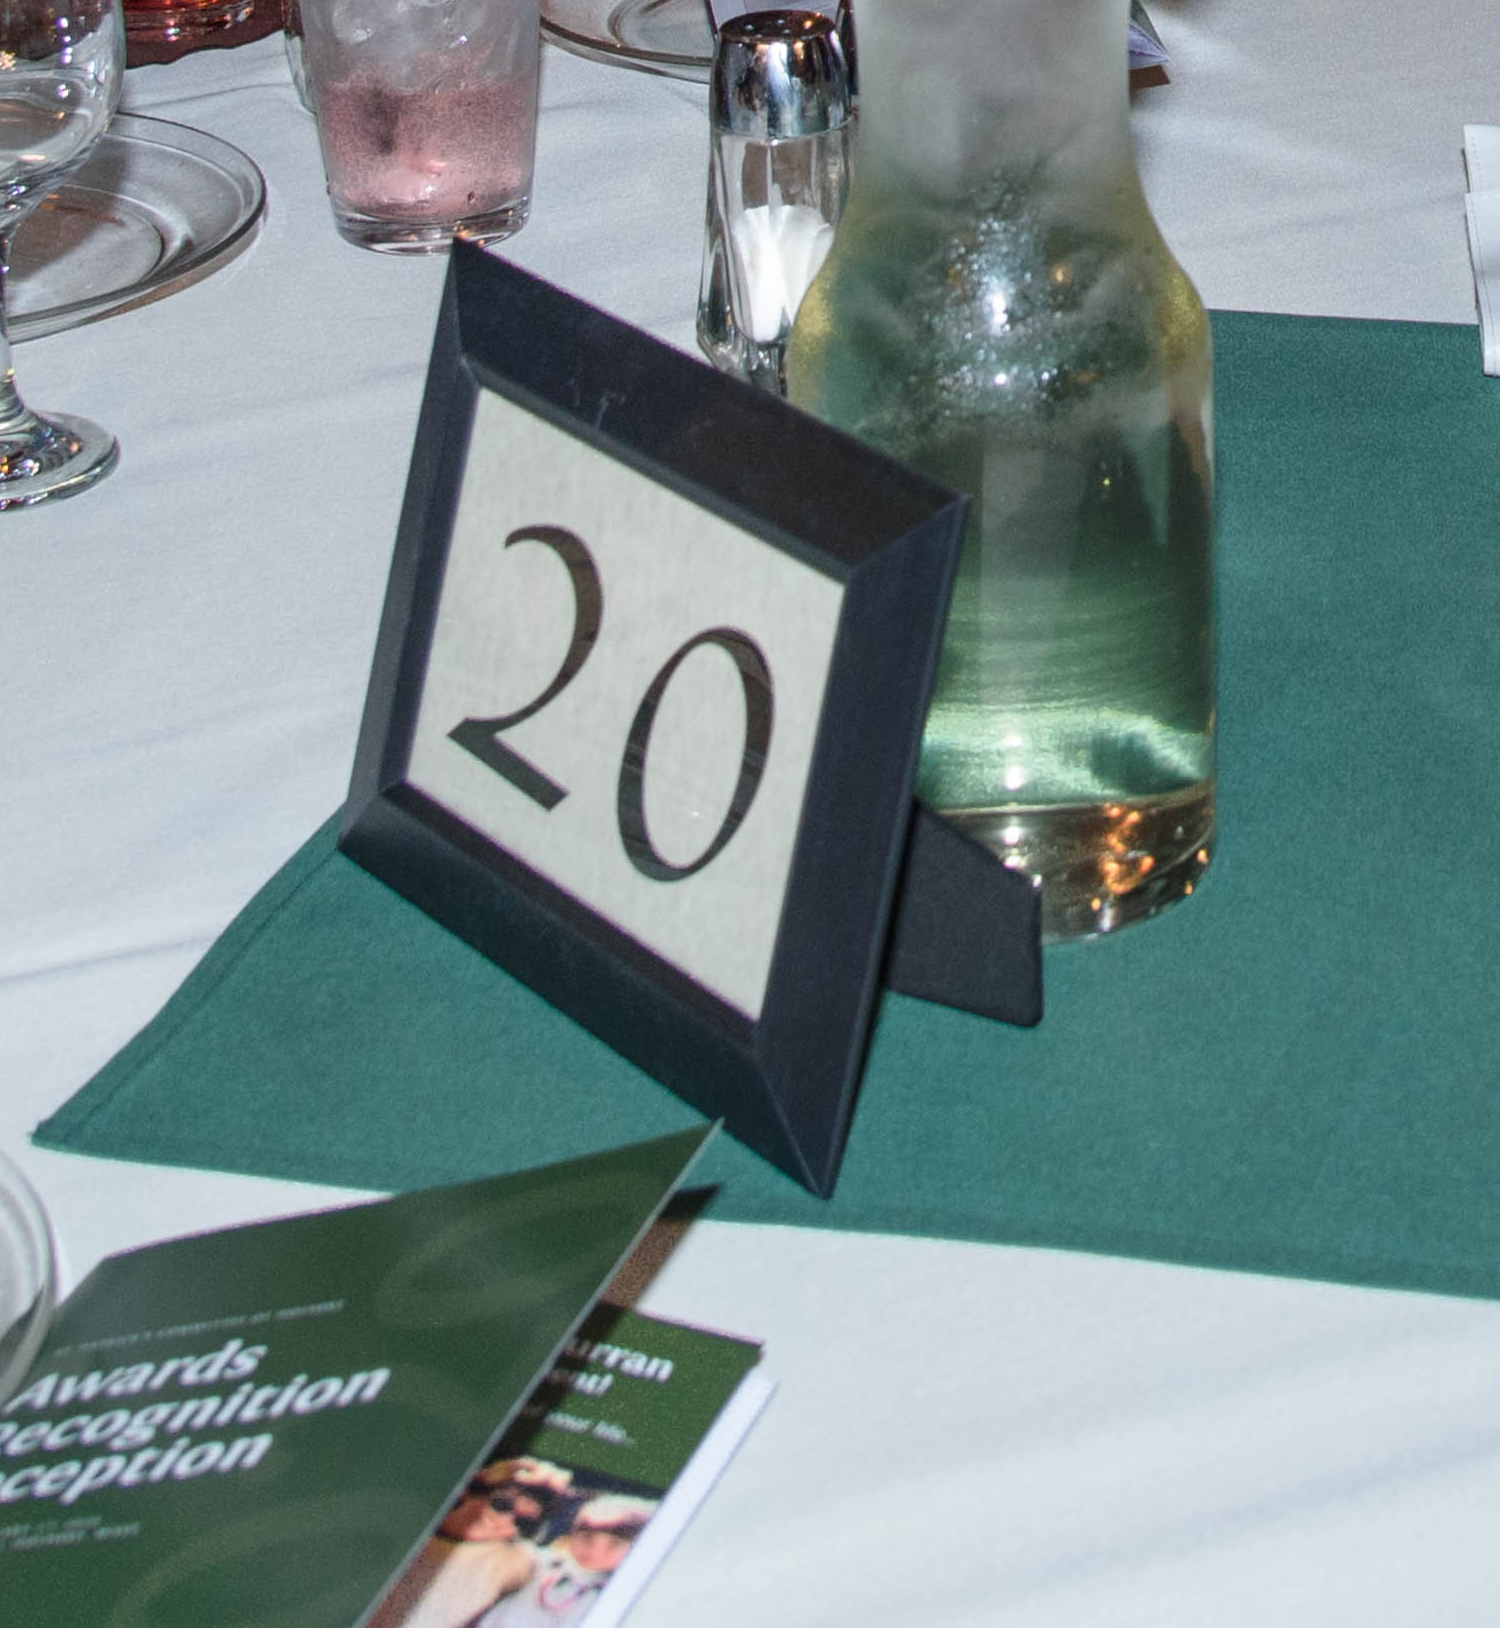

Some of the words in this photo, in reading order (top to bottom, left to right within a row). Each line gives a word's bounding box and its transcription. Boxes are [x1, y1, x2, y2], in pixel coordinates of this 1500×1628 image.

[446, 522, 775, 883] 20
[5, 1337, 271, 1416] Awards
[565, 1339, 674, 1383] urran
